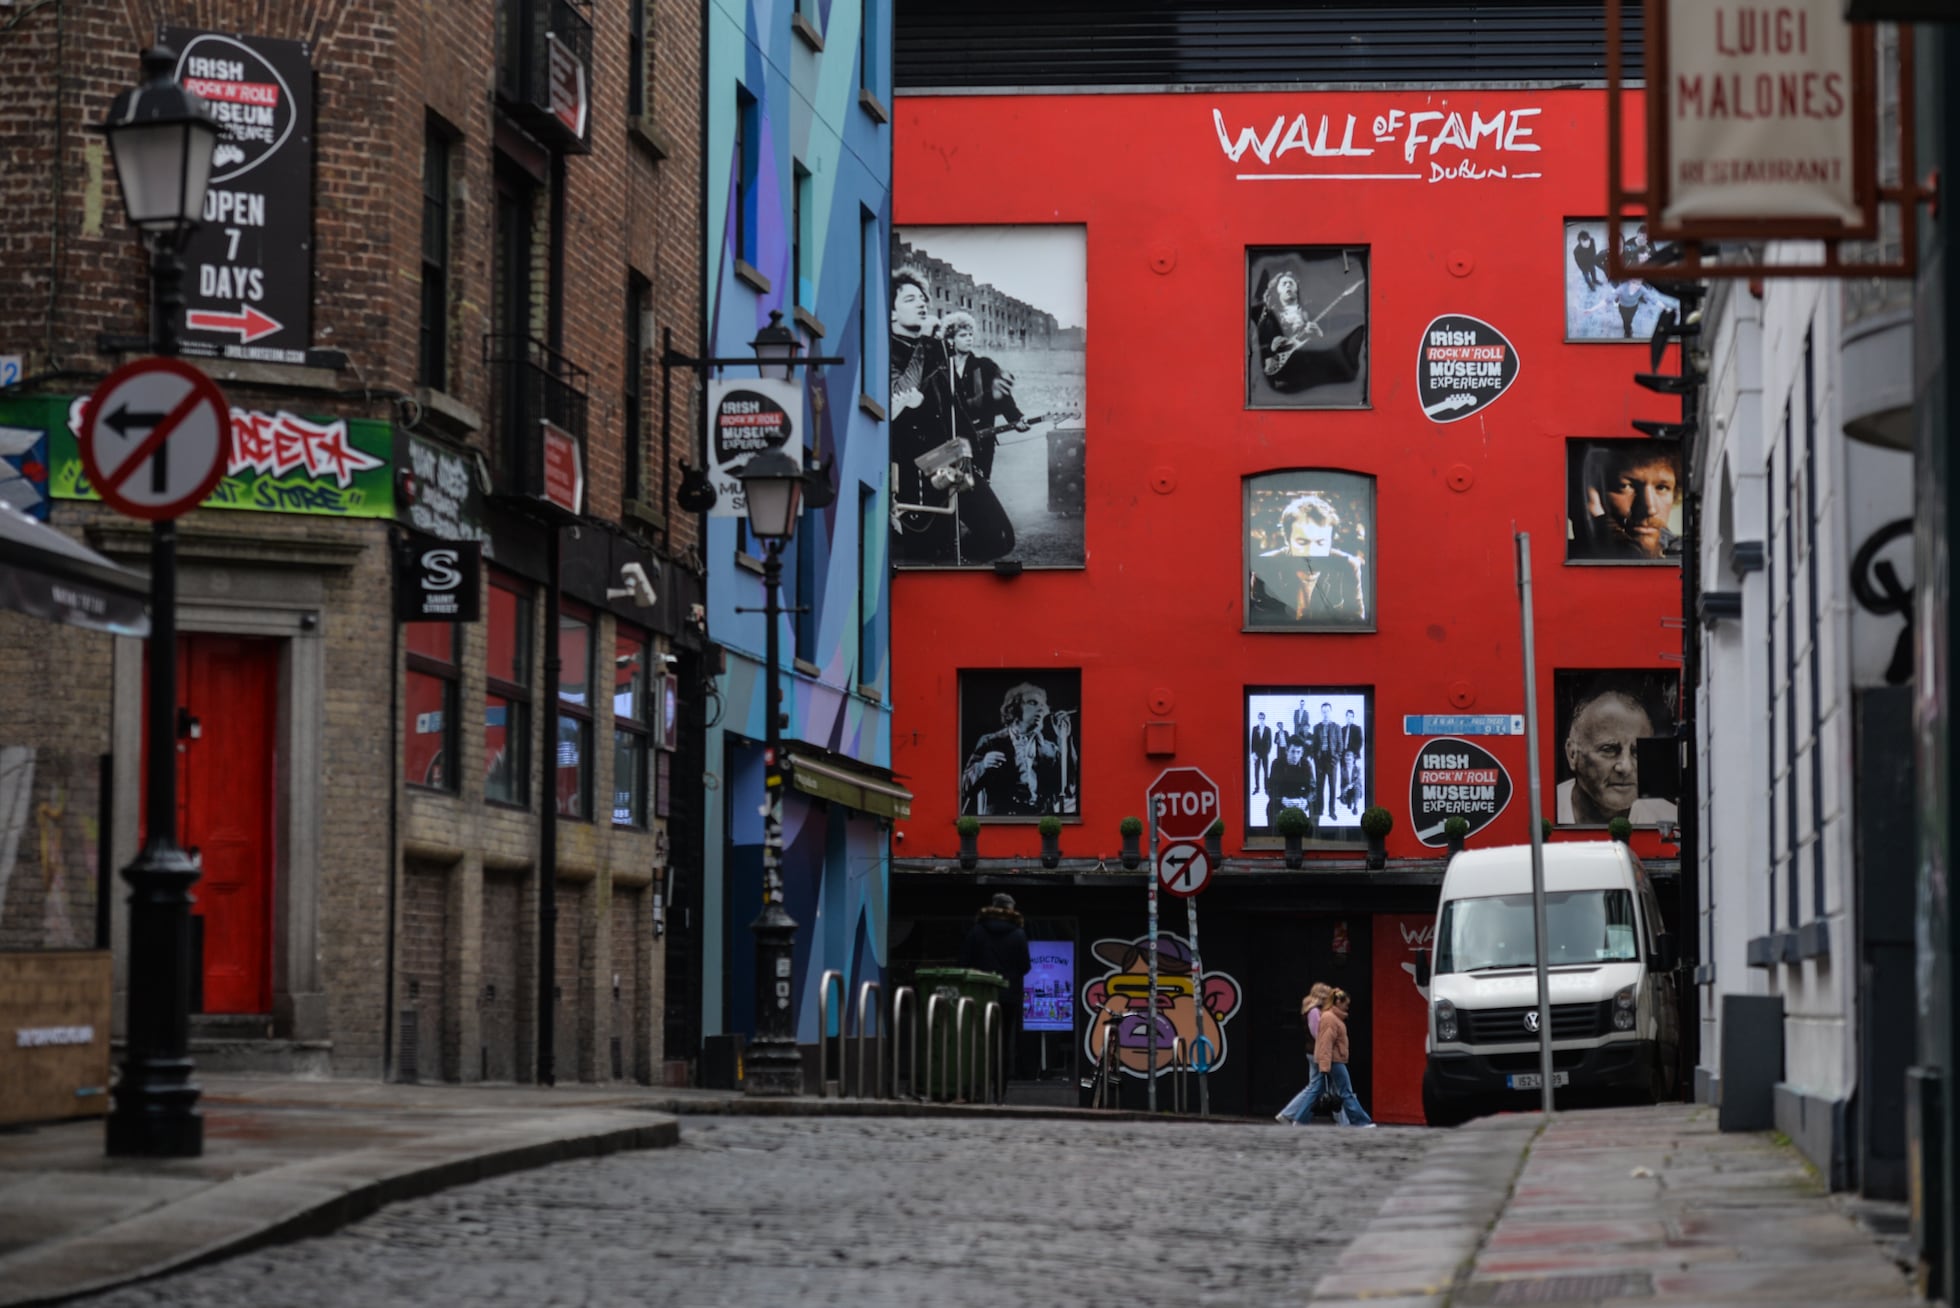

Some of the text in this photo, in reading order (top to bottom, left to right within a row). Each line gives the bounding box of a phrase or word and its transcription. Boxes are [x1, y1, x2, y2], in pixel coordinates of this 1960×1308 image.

[1715, 8, 1808, 56] LUIGI
[188, 56, 244, 81] IRISH
[1678, 72, 1844, 120] MALONES
[1212, 108, 1542, 164] WALL OF FAME
[1428, 159, 1508, 184] DUBLIN
[1679, 158, 1842, 186] RESTAURANT
[204, 190, 265, 227] OPEN
[225, 229, 242, 261] 7
[200, 263, 264, 301] DAYS
[1430, 331, 1476, 346] IRISH
[1428, 347, 1503, 361] ROCK'N'ROLL
[1430, 361, 1501, 377] MUSEUM
[1430, 376, 1502, 390] EXPERIENCE
[722, 401, 760, 414] IRISH
[422, 603, 459, 614] STREET
[1423, 754, 1469, 769] IRISH
[1420, 770, 1497, 783] ROCK'N'ROLL
[1422, 785, 1495, 801] MUSEUM
[1153, 791, 1215, 816] STOP
[1423, 800, 1495, 813] EXPERIENCE
